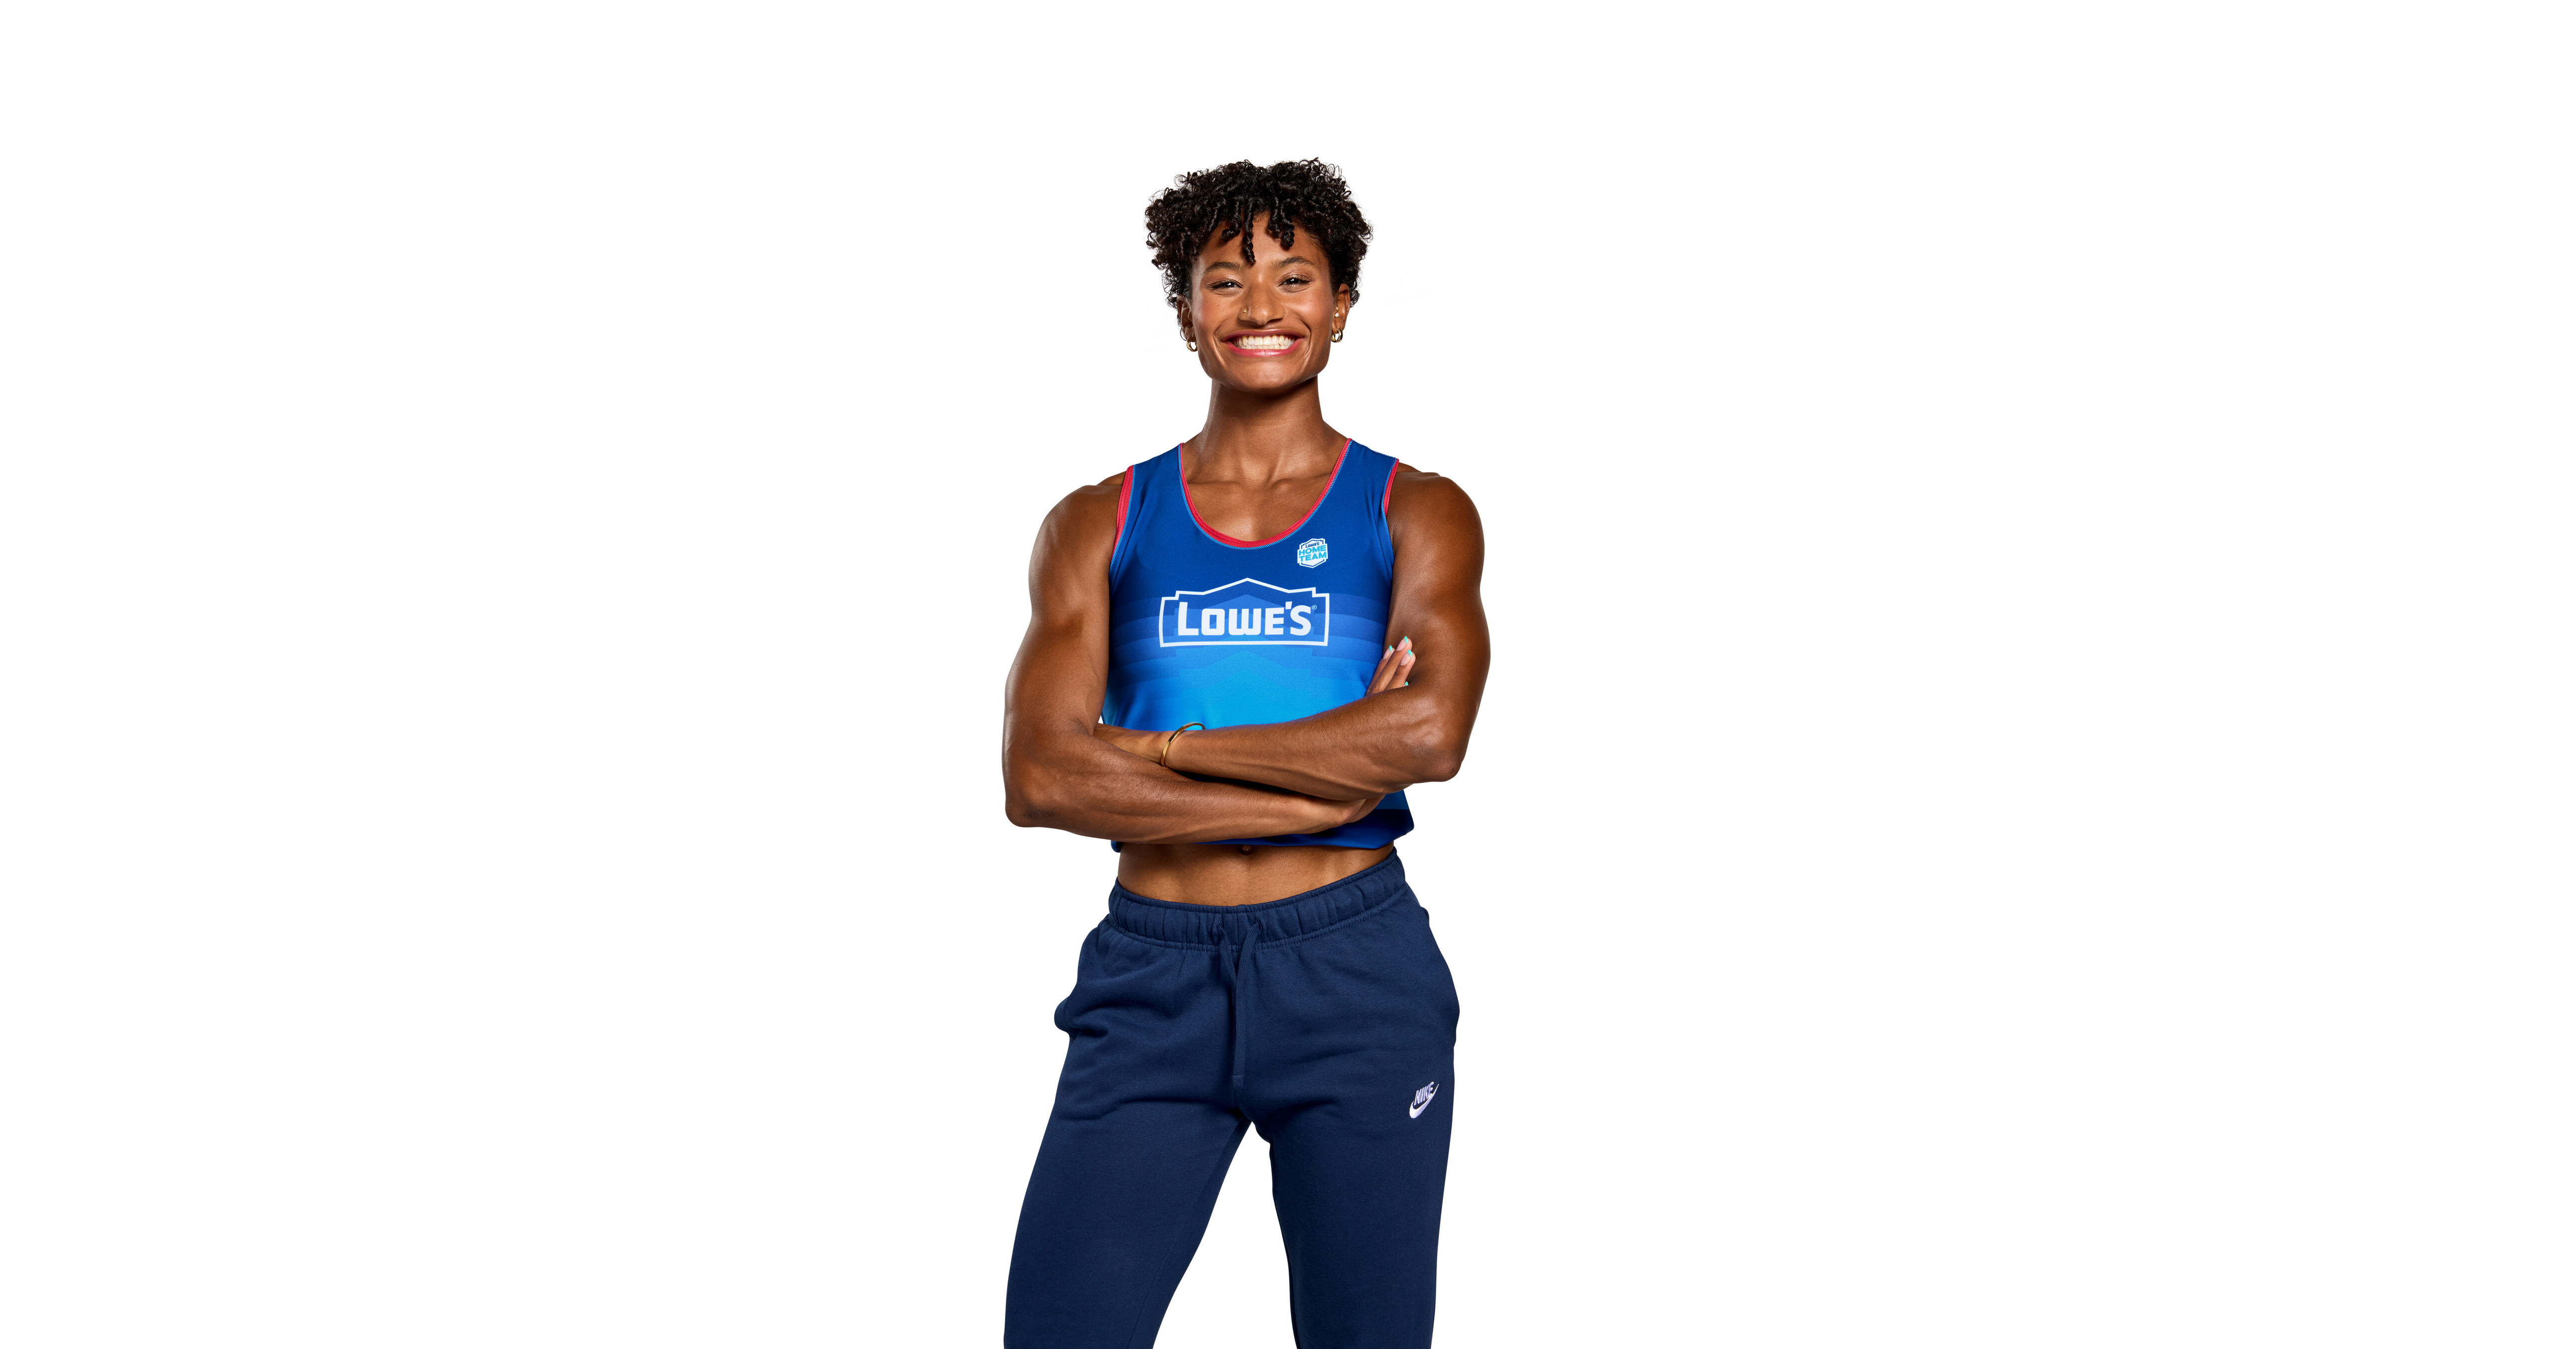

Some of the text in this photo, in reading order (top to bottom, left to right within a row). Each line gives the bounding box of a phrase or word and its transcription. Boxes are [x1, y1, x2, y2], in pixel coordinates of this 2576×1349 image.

[1299, 545, 1326, 556] HOME
[1299, 552, 1327, 562] TEAM
[1178, 601, 1311, 636] LOWE'S
[1414, 1081, 1434, 1106] NIKE
